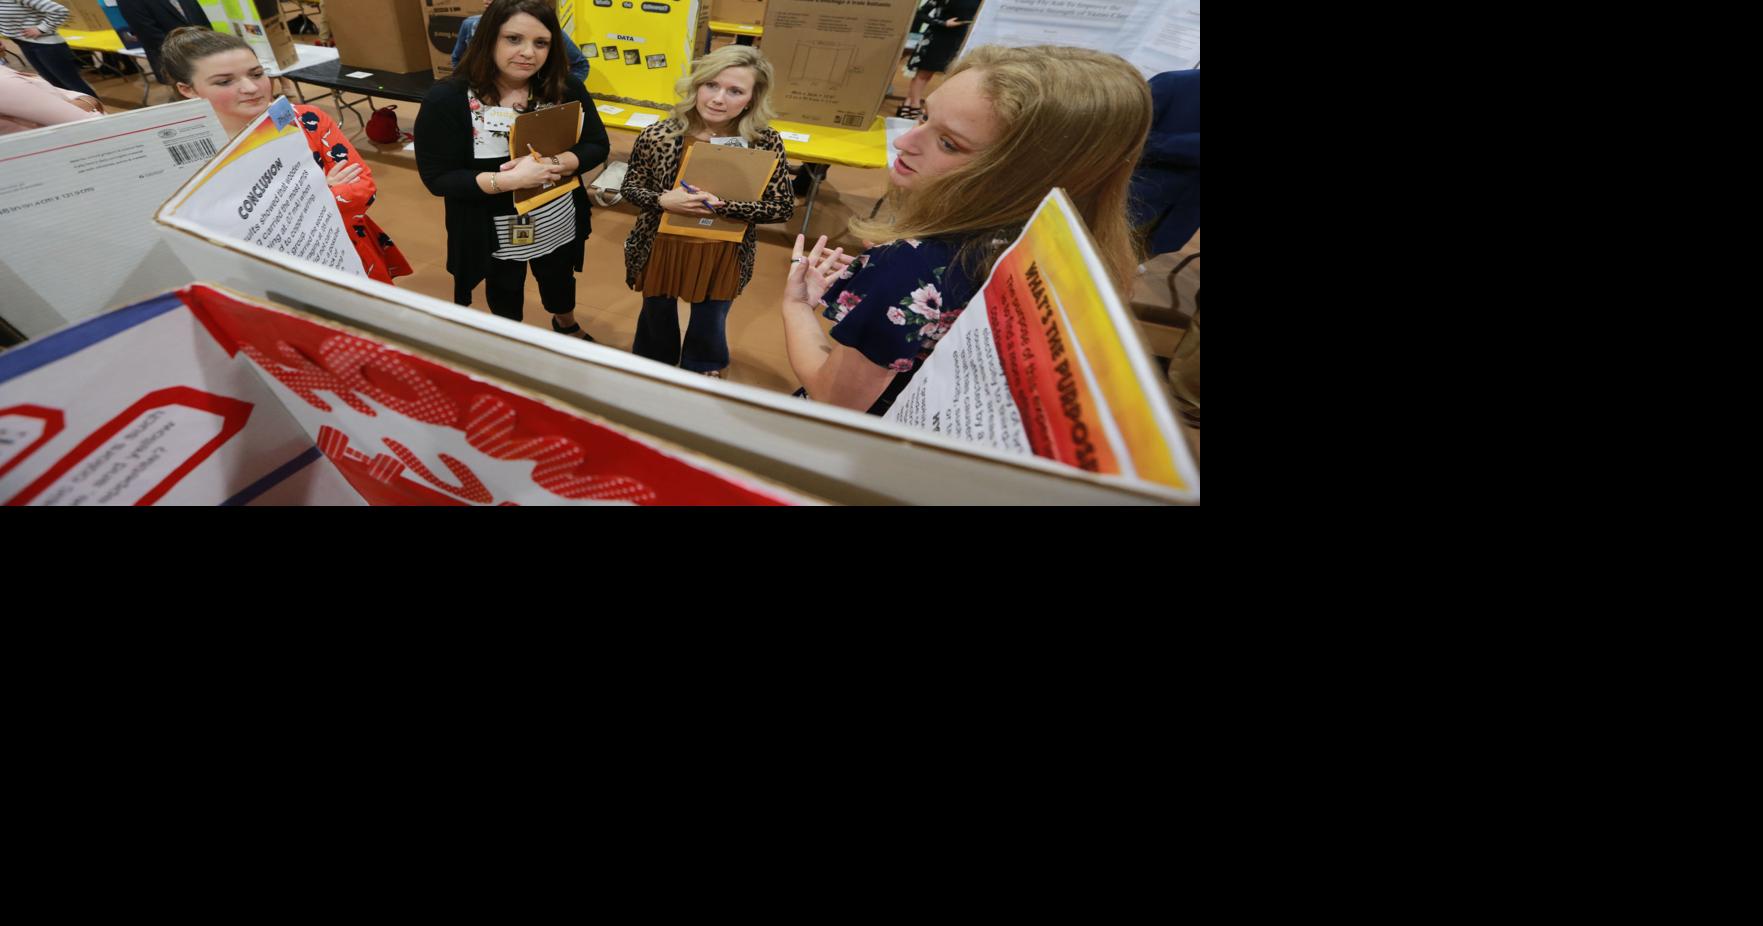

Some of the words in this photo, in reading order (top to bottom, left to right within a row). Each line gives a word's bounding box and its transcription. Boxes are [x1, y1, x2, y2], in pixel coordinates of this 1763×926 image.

[617, 34, 634, 42] DATA
[238, 157, 283, 219] CONCLUSION
[1024, 260, 1053, 326] WHAT'S
[1045, 319, 1065, 362] THE
